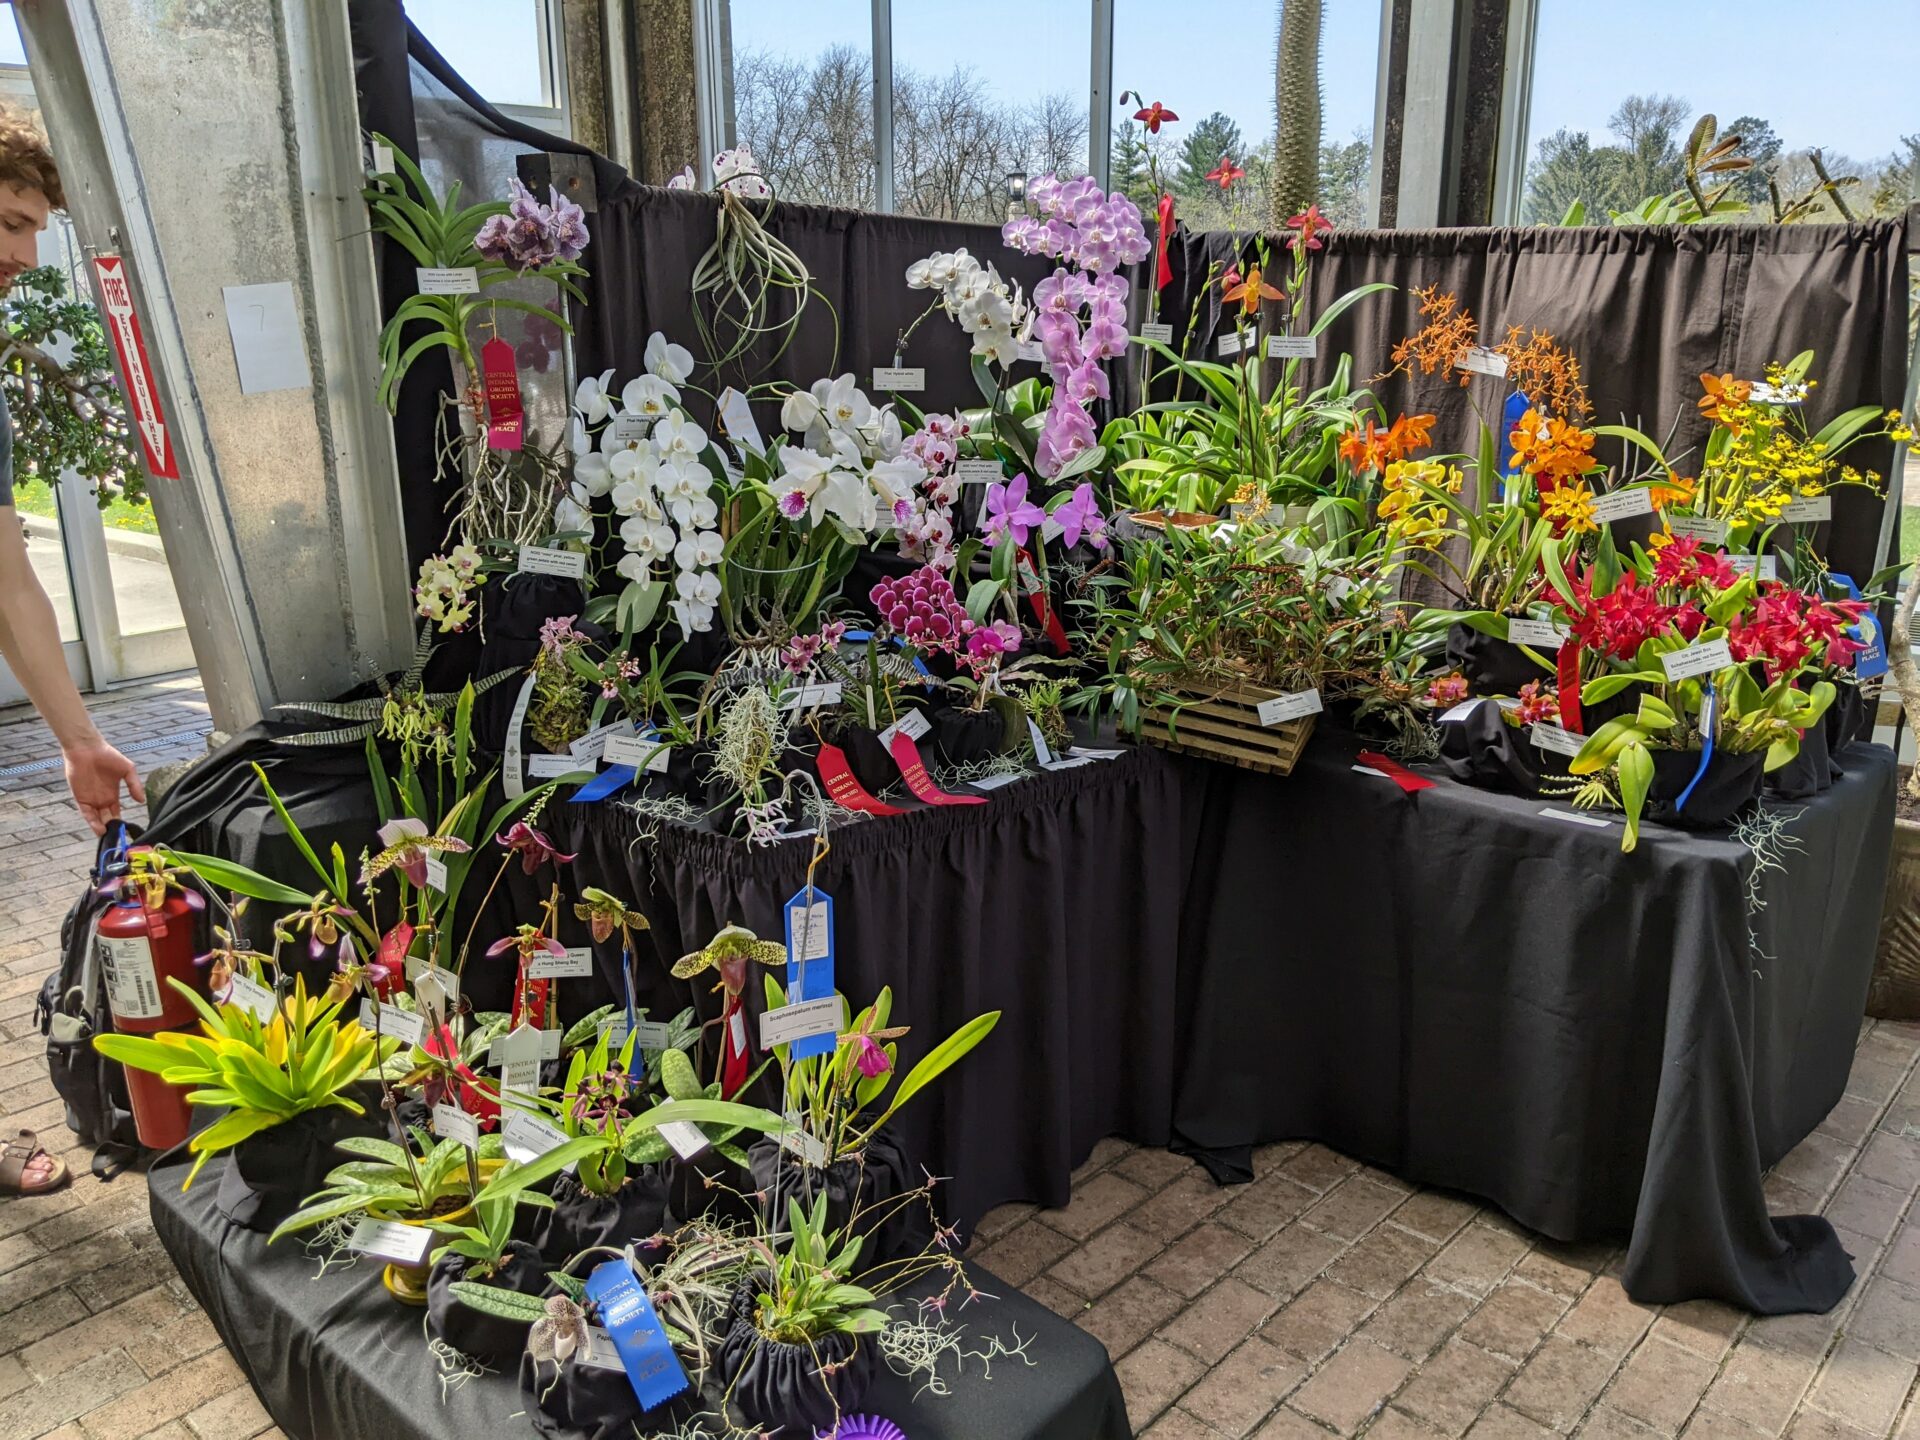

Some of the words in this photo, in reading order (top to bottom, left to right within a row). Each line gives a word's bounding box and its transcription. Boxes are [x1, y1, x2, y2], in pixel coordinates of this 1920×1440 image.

[103, 278, 128, 307] FIRE
[119, 313, 163, 457] EXTINGUISHER
[1861, 652, 1881, 662] PLACE
[1862, 646, 1879, 656] FIRST
[904, 762, 923, 776] CENTRAL
[827, 771, 850, 786] CENTRAL
[908, 770, 925, 784] INDIANA
[911, 777, 927, 789] ORCHID
[832, 780, 854, 794] INDIANA
[839, 788, 859, 800] ORCHID
[769, 1006, 811, 1022] Scaphosepalum
[507, 1059, 537, 1070] CENTRAL
[508, 1070, 536, 1081] INDIANA
[545, 1127, 558, 1141] Black
[604, 1287, 636, 1306] INDIANA
[608, 1296, 640, 1316] ORCHID
[612, 1306, 646, 1328] SOCIETY
